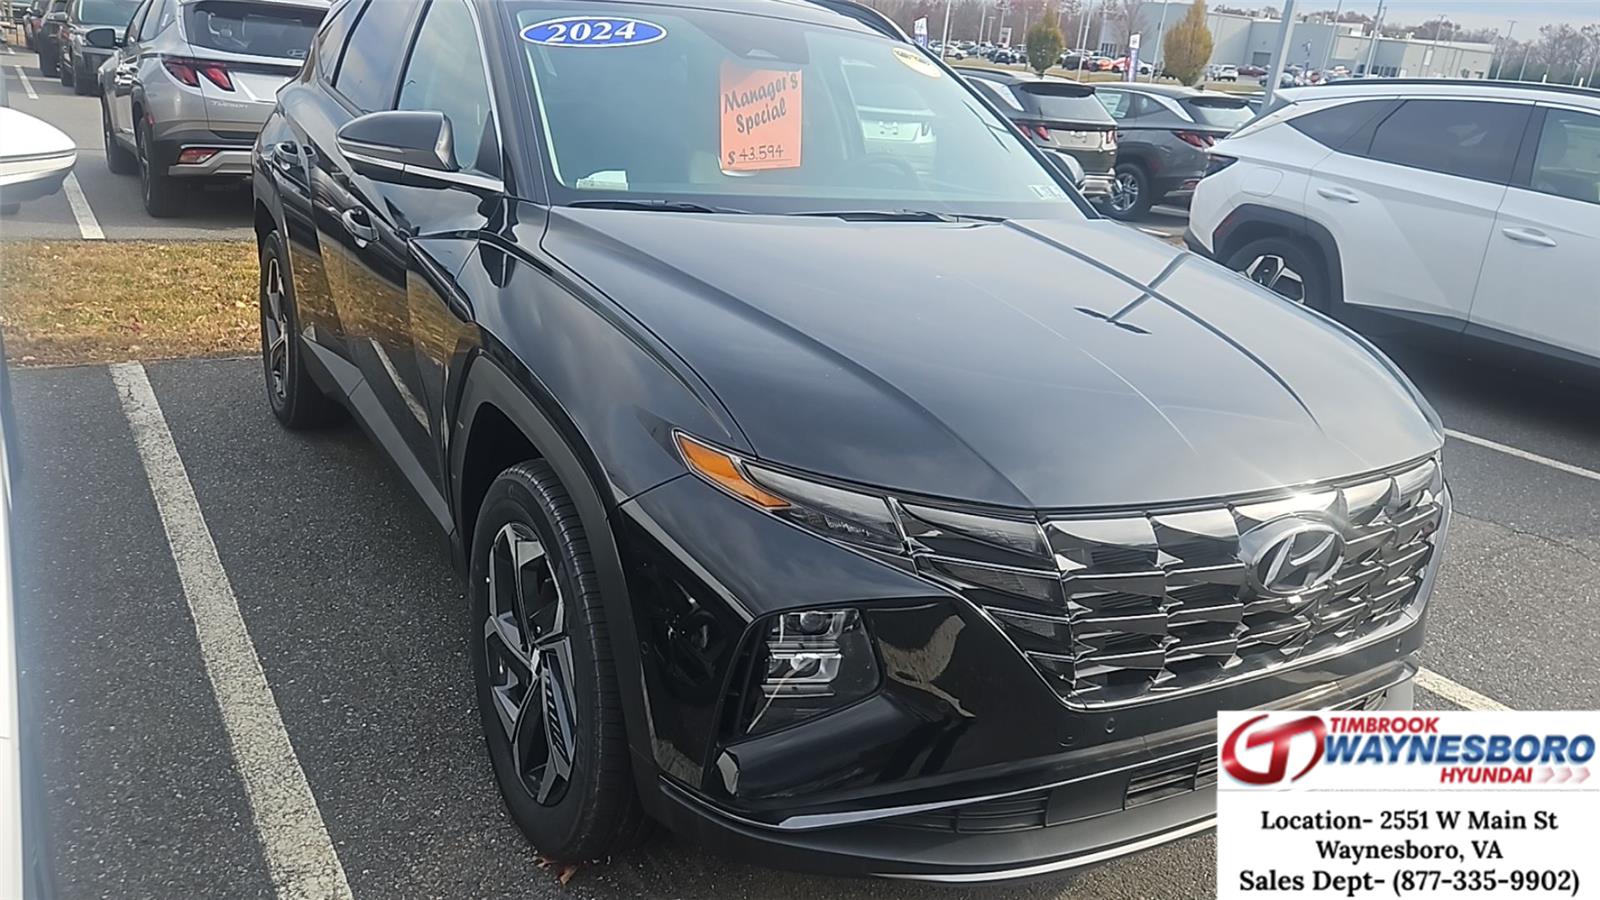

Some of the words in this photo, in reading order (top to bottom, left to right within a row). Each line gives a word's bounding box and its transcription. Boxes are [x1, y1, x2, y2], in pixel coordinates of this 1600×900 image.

[545, 21, 636, 42] 2024
[724, 72, 798, 114] Manager's
[736, 97, 786, 135] Special
